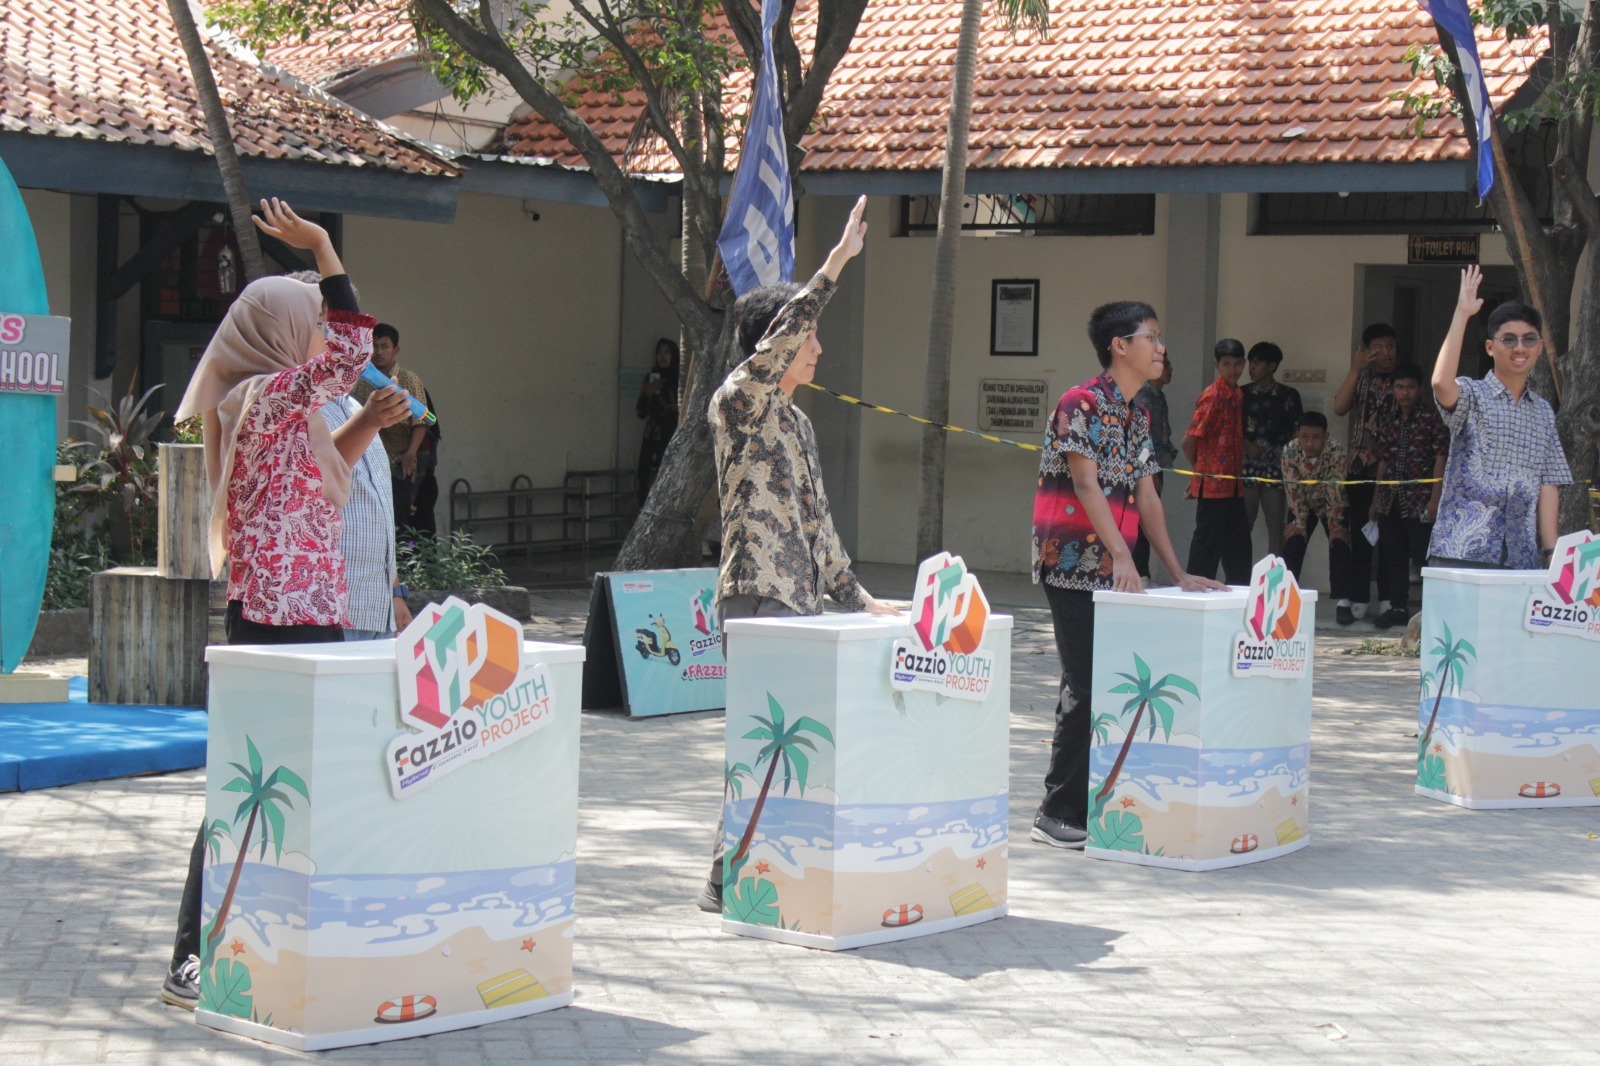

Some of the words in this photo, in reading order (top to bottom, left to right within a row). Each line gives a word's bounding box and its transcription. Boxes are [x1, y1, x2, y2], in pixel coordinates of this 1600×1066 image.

[1425, 241, 1454, 255] TOILET
[1456, 241, 1475, 255] PRIA
[1531, 600, 1588, 623] Fazzio
[689, 634, 722, 651] Fazzio
[1237, 640, 1274, 660] Fazzio
[1276, 639, 1306, 658] YOUTH
[896, 647, 946, 675] Fazzio
[948, 652, 992, 679] YOUTH
[1273, 658, 1305, 671] PROJECT
[945, 674, 990, 694] PROJECT
[474, 673, 548, 728] YOUTH
[480, 697, 550, 748] PROJECT
[395, 720, 477, 777] Fazzio
